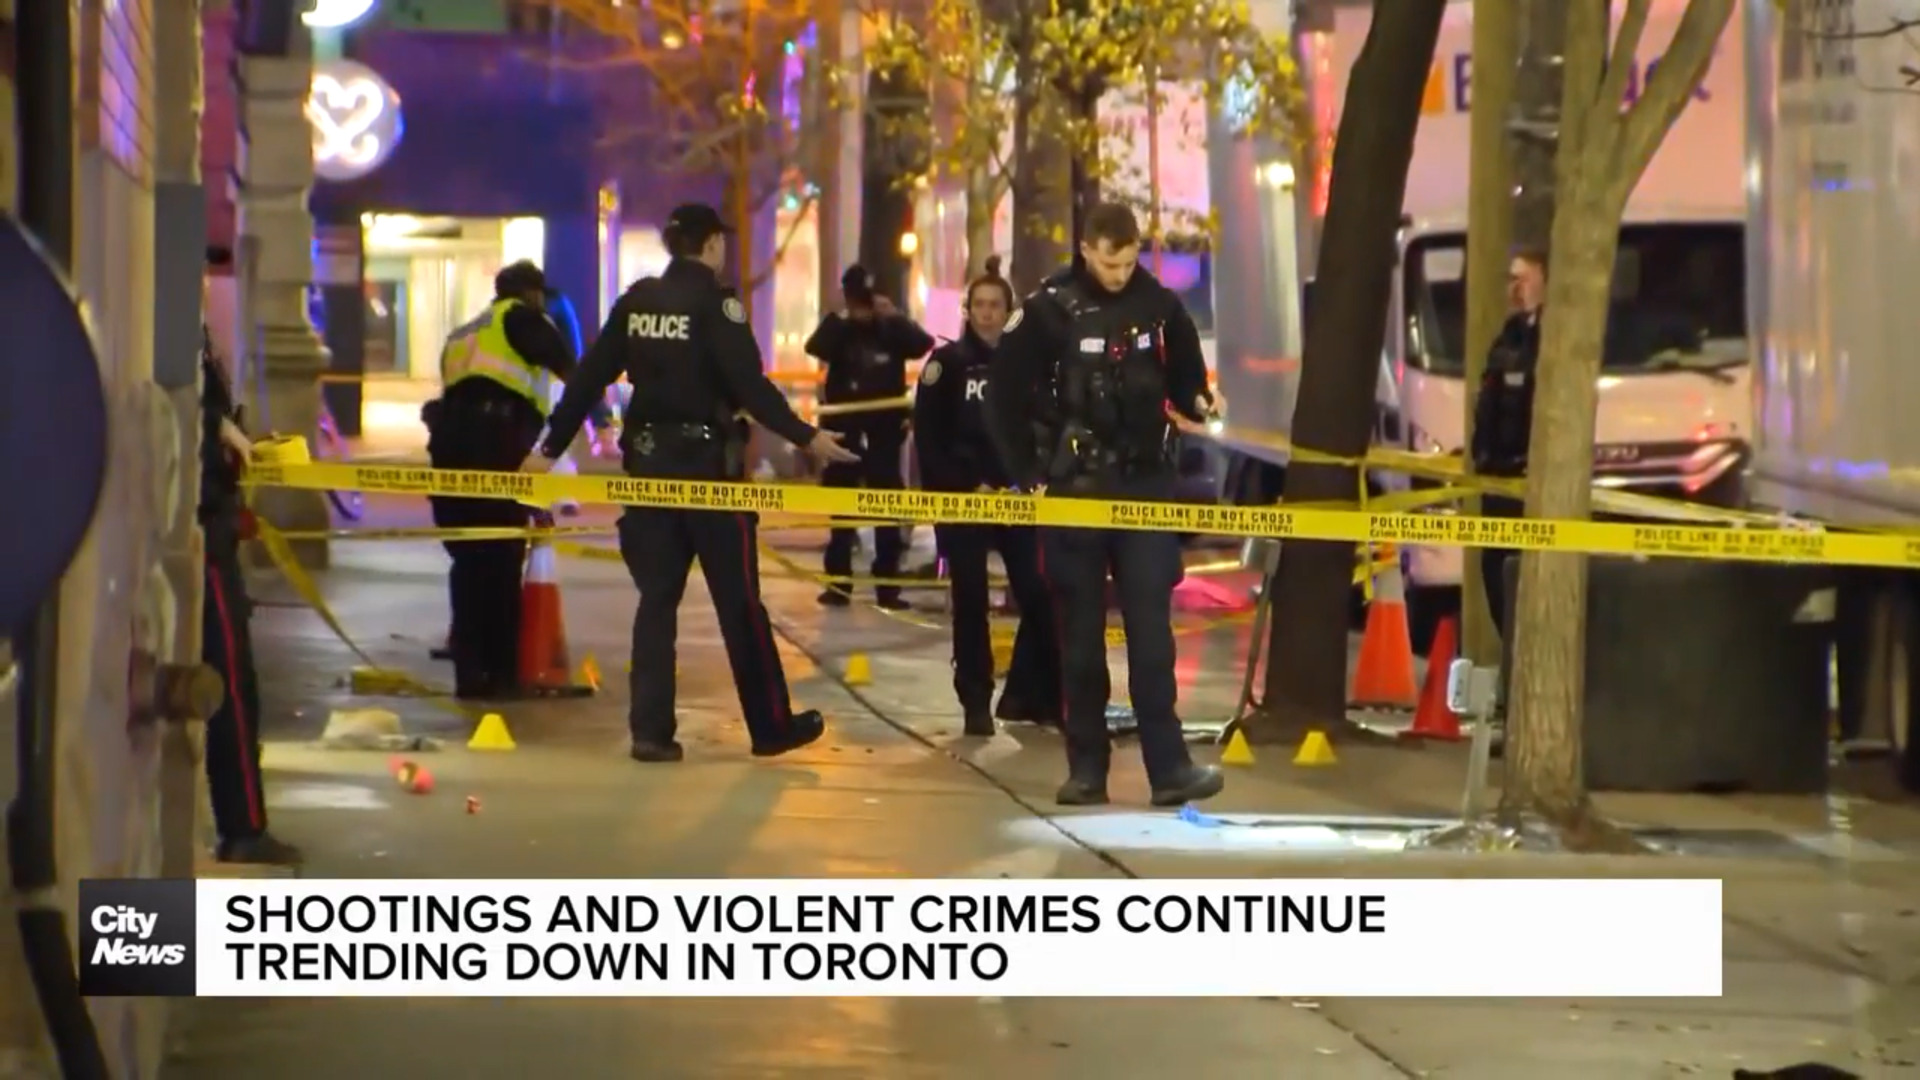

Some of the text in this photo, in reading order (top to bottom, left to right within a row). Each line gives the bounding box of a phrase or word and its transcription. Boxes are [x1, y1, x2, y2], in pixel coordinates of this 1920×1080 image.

[628, 313, 690, 340] POLICE
[607, 481, 783, 500] POLICE LINE DO NOT CROSS
[858, 493, 1036, 512] POLICE LINE DO NOT CROSS
[1112, 504, 1293, 525] POLICE LINE DO NOT CROSS
[1371, 516, 1556, 536] POLICE LINE DO NOT CROSS
